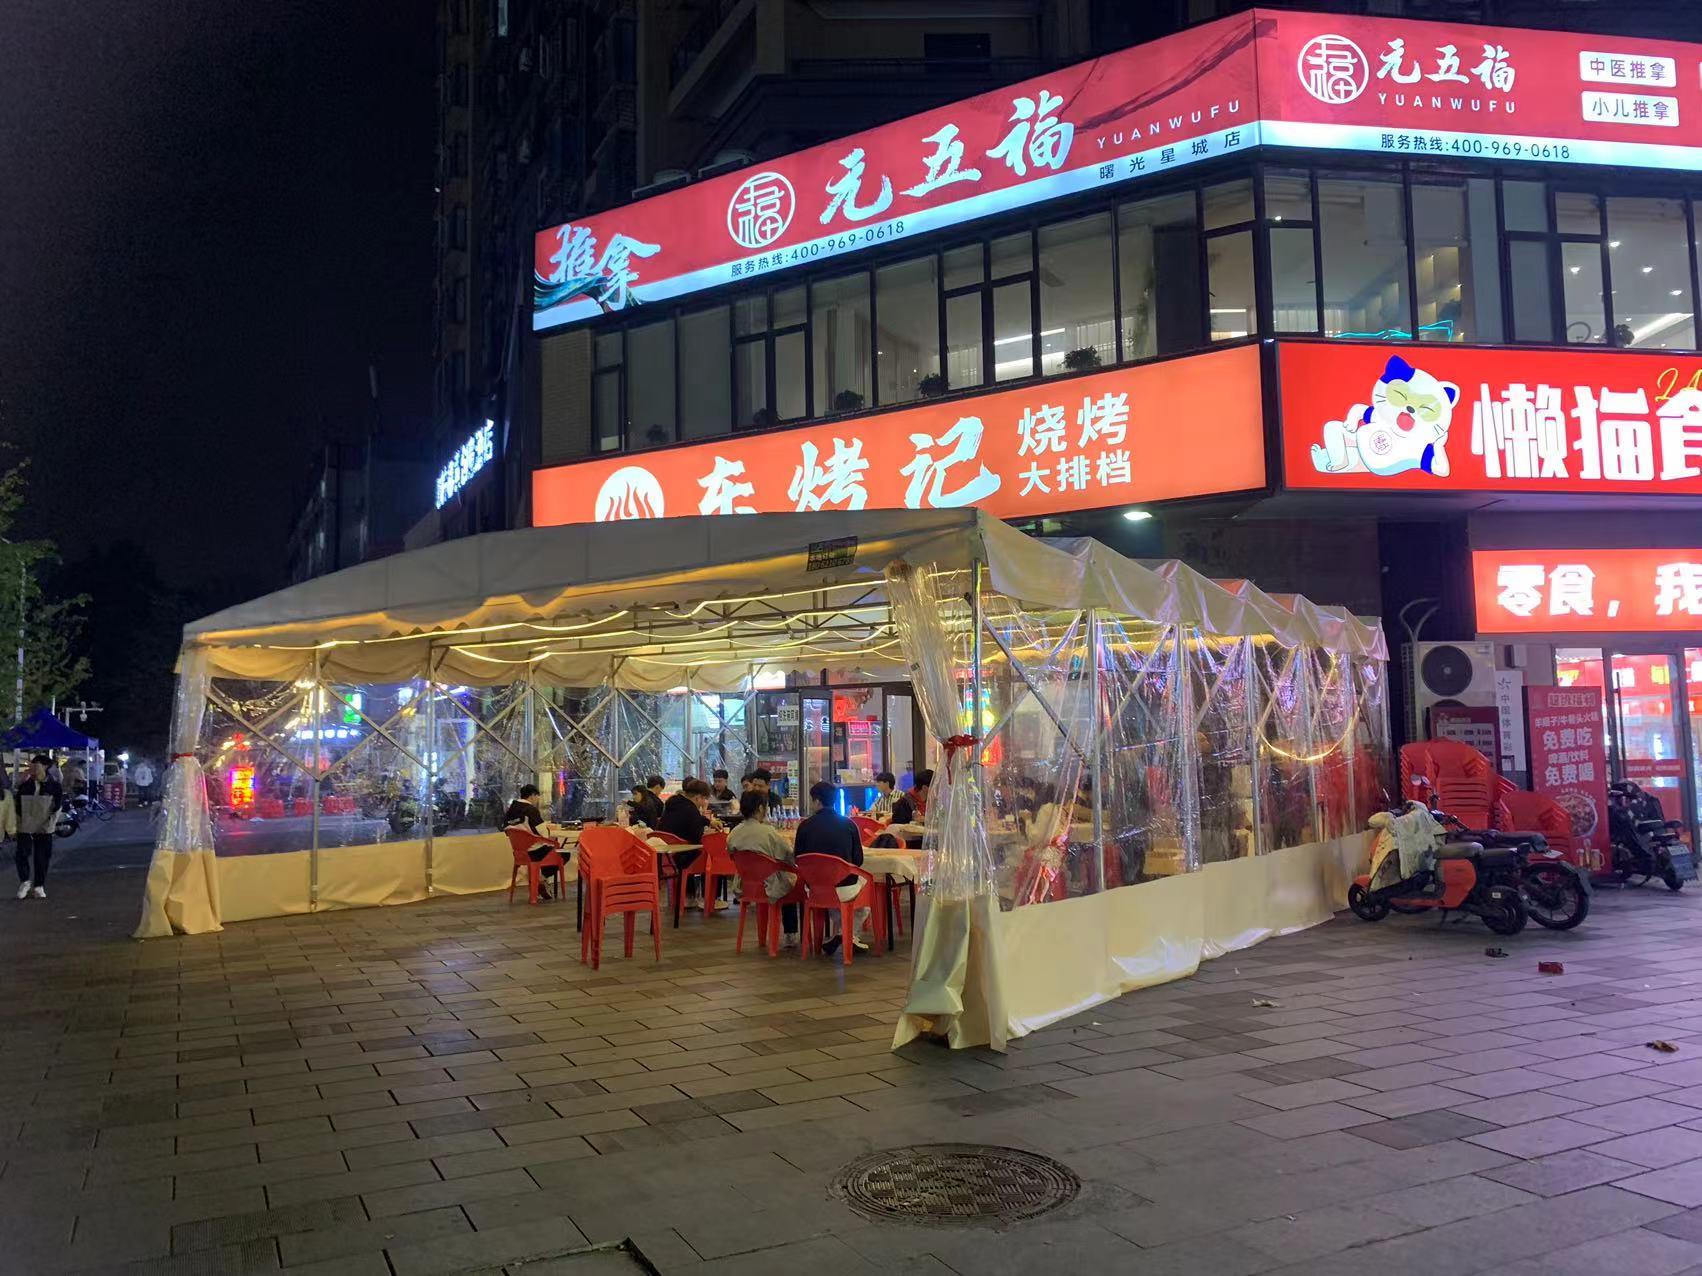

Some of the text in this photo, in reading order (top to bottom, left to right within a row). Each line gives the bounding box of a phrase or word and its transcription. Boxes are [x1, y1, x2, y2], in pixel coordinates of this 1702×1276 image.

[1376, 38, 1516, 92] 元五福
[1590, 57, 1666, 80] 中医推拿
[1097, 99, 1240, 149] YUANWUFU
[1378, 92, 1516, 113] YUANWUFU
[1593, 97, 1670, 120] 小儿推拿
[819, 90, 1076, 224] 元五福
[1100, 131, 1241, 179] 曙光星城店
[1381, 133, 1570, 159] 服务热线:400-969-0618
[549, 224, 661, 311] 推拿
[731, 221, 905, 277] 服务热线:400-969-0618
[1017, 392, 1130, 456] 烧烤
[1018, 449, 1131, 497] 大排档
[1543, 727, 1593, 750] 免费吃
[1545, 762, 1594, 787] 免费喝
